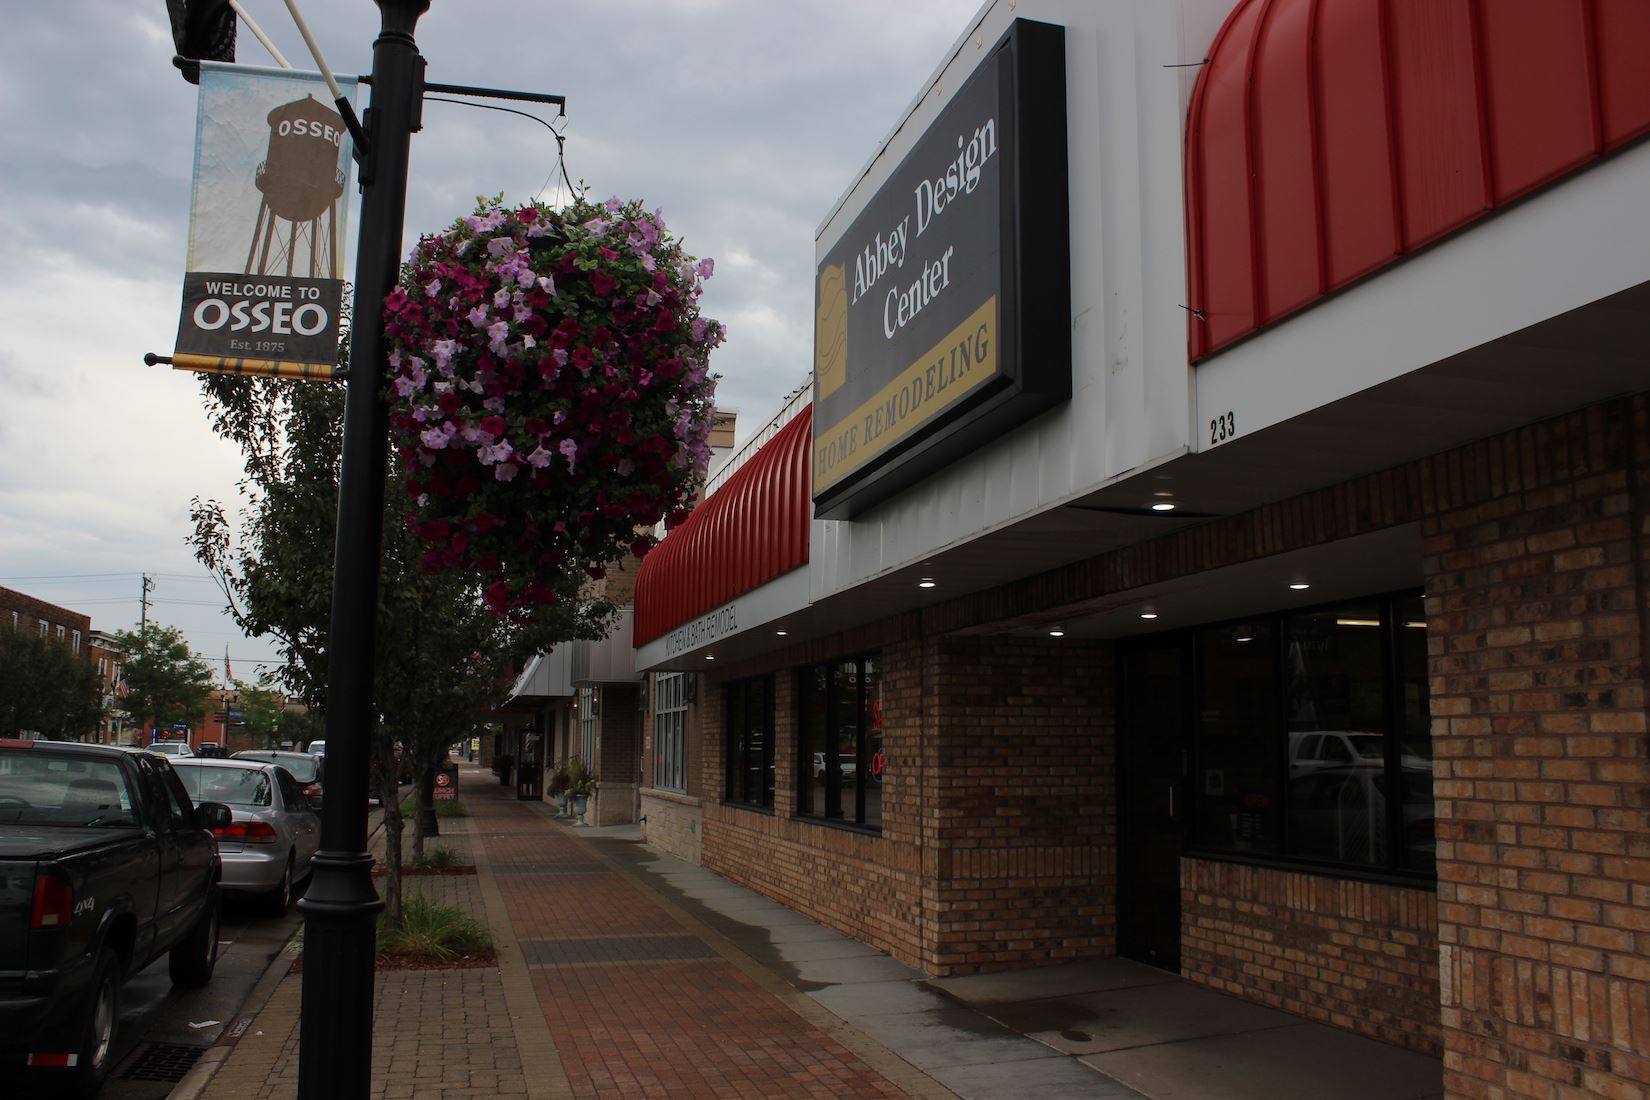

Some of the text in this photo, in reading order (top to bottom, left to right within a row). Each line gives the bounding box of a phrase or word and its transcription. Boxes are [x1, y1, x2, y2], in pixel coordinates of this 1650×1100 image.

[278, 118, 340, 148] OSSEO
[851, 117, 997, 305] Abbey Design
[205, 281, 320, 301] WELCOME TO
[883, 245, 954, 340] Center
[193, 298, 328, 337] OSSEO
[255, 340, 285, 353] 1875
[817, 323, 989, 478] HOME REMODELING
[1210, 411, 1235, 445] 233
[707, 605, 738, 641] REMODEL
